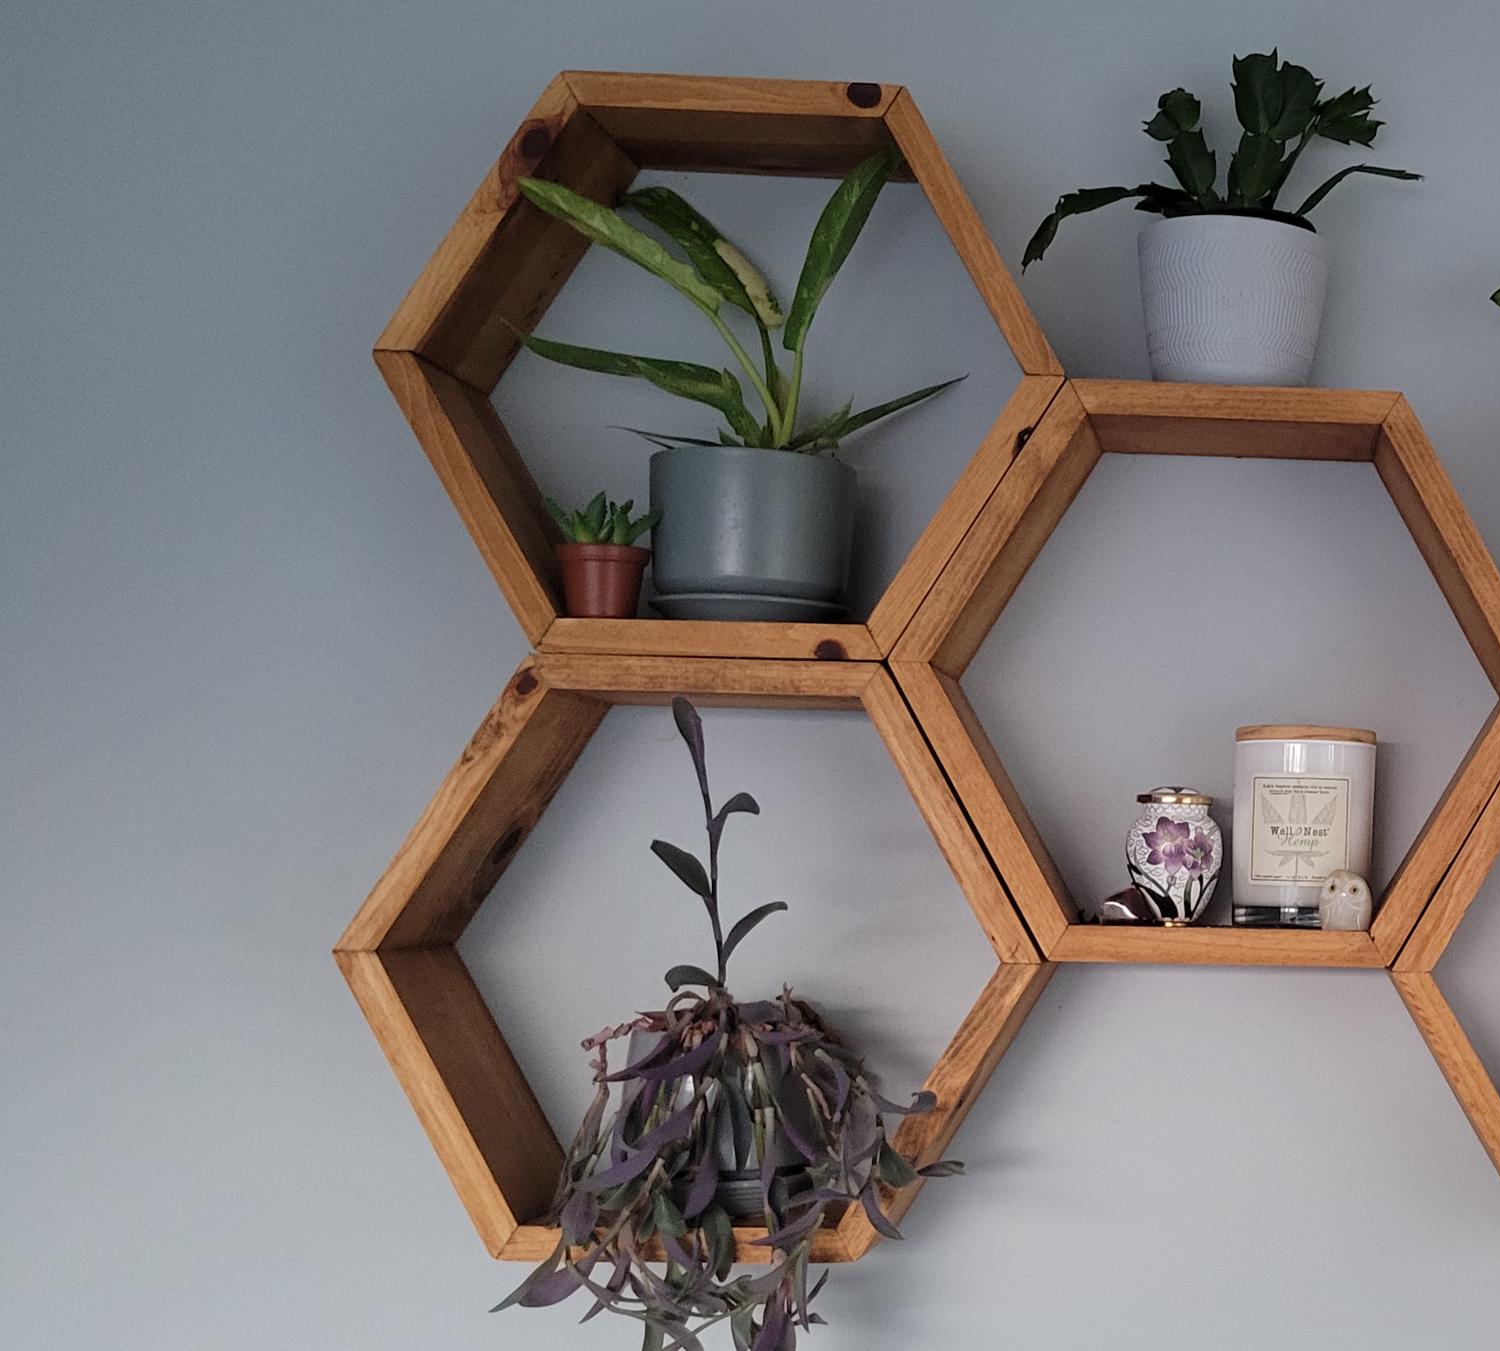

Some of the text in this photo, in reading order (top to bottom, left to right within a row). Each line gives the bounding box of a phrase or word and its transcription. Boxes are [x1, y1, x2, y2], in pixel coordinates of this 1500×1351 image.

[1270, 826, 1328, 837] Well Nest
[1278, 833, 1319, 850] Hemp
